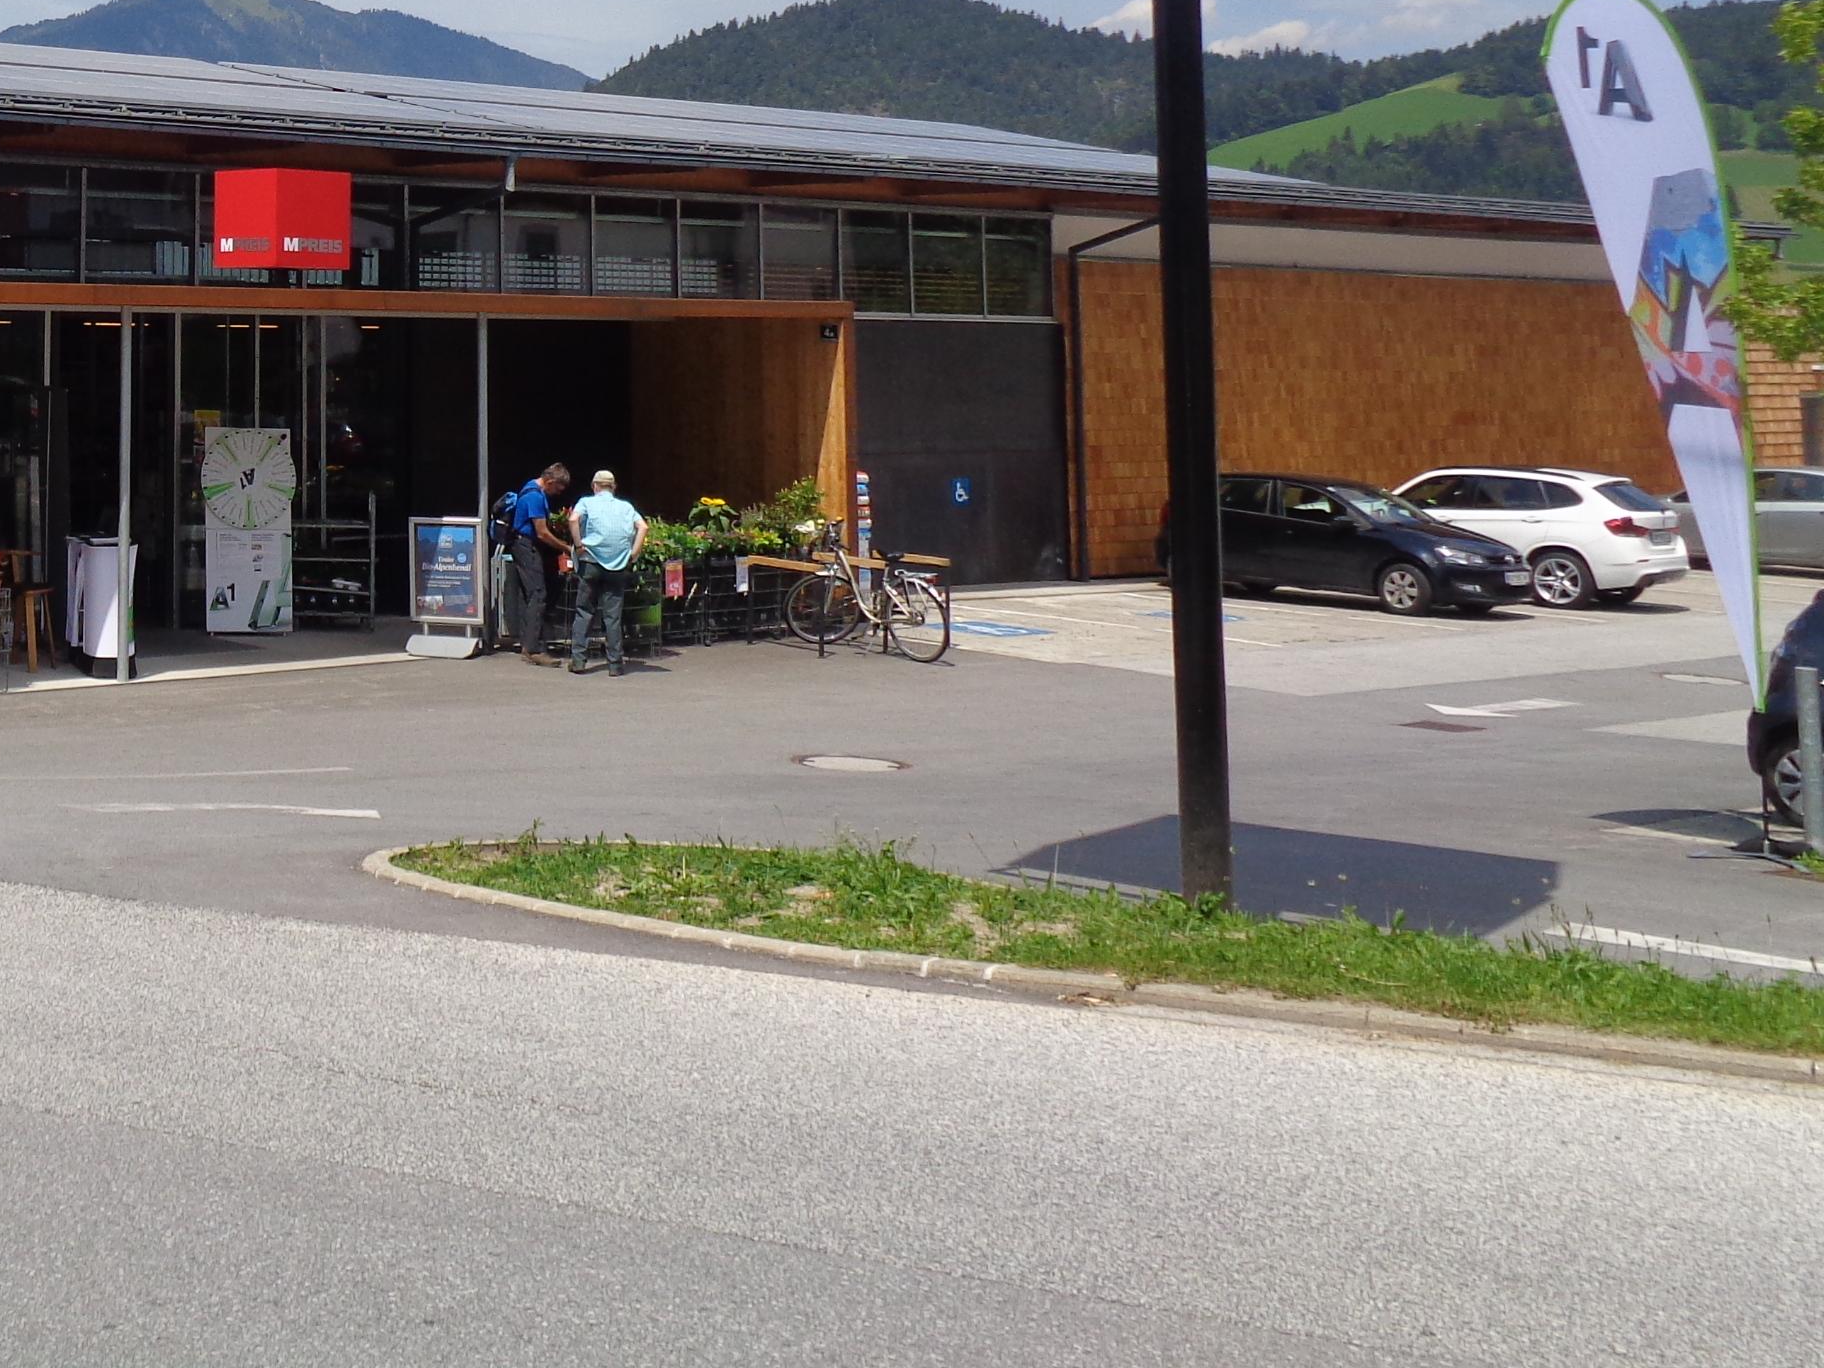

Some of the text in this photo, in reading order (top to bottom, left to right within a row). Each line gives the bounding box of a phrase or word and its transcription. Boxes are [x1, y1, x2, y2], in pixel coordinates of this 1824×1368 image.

[220, 236, 271, 252] MPREIS
[283, 237, 343, 252] MPREIS
[210, 583, 236, 611] A1
